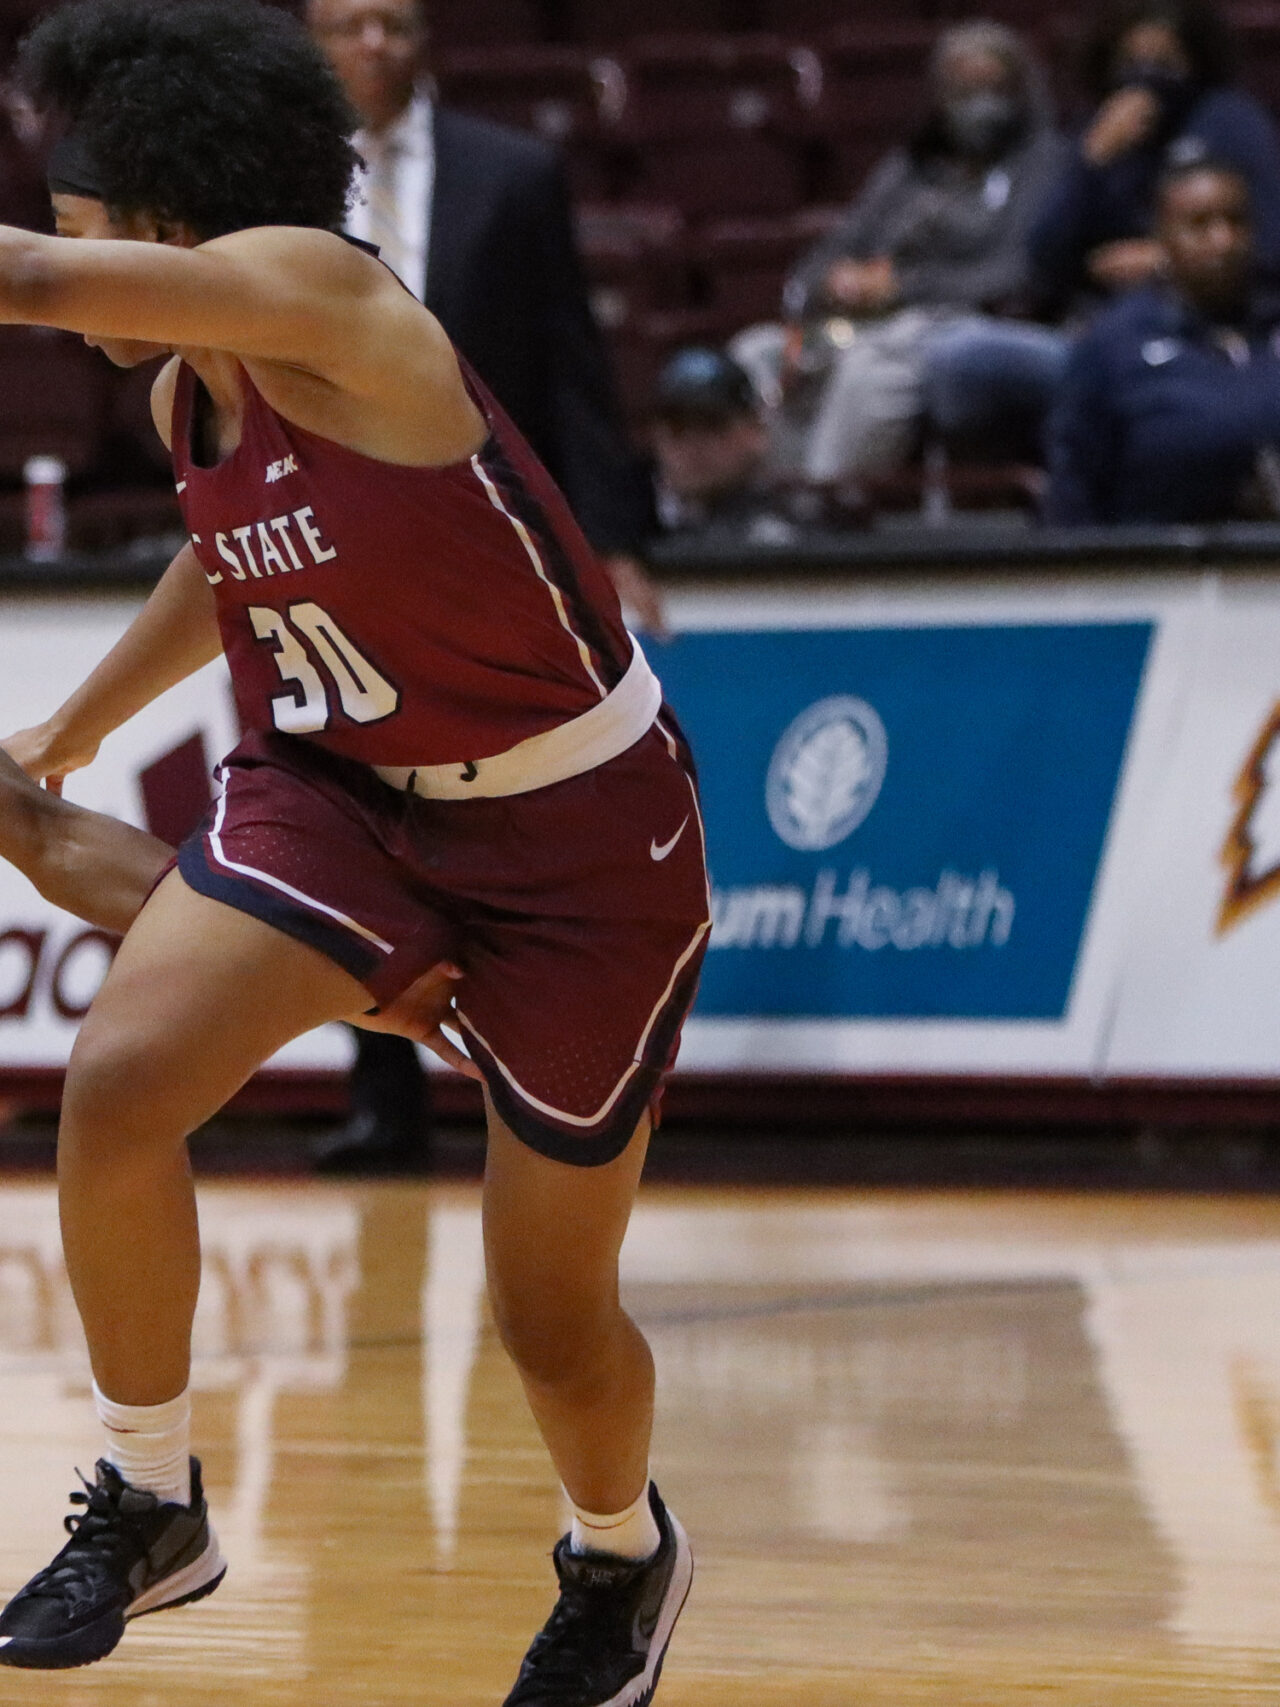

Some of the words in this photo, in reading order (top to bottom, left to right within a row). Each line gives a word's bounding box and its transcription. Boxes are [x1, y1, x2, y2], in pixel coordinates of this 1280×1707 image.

[215, 505, 338, 581] STATE
[246, 601, 399, 735] 30
[805, 867, 1016, 950] Health
